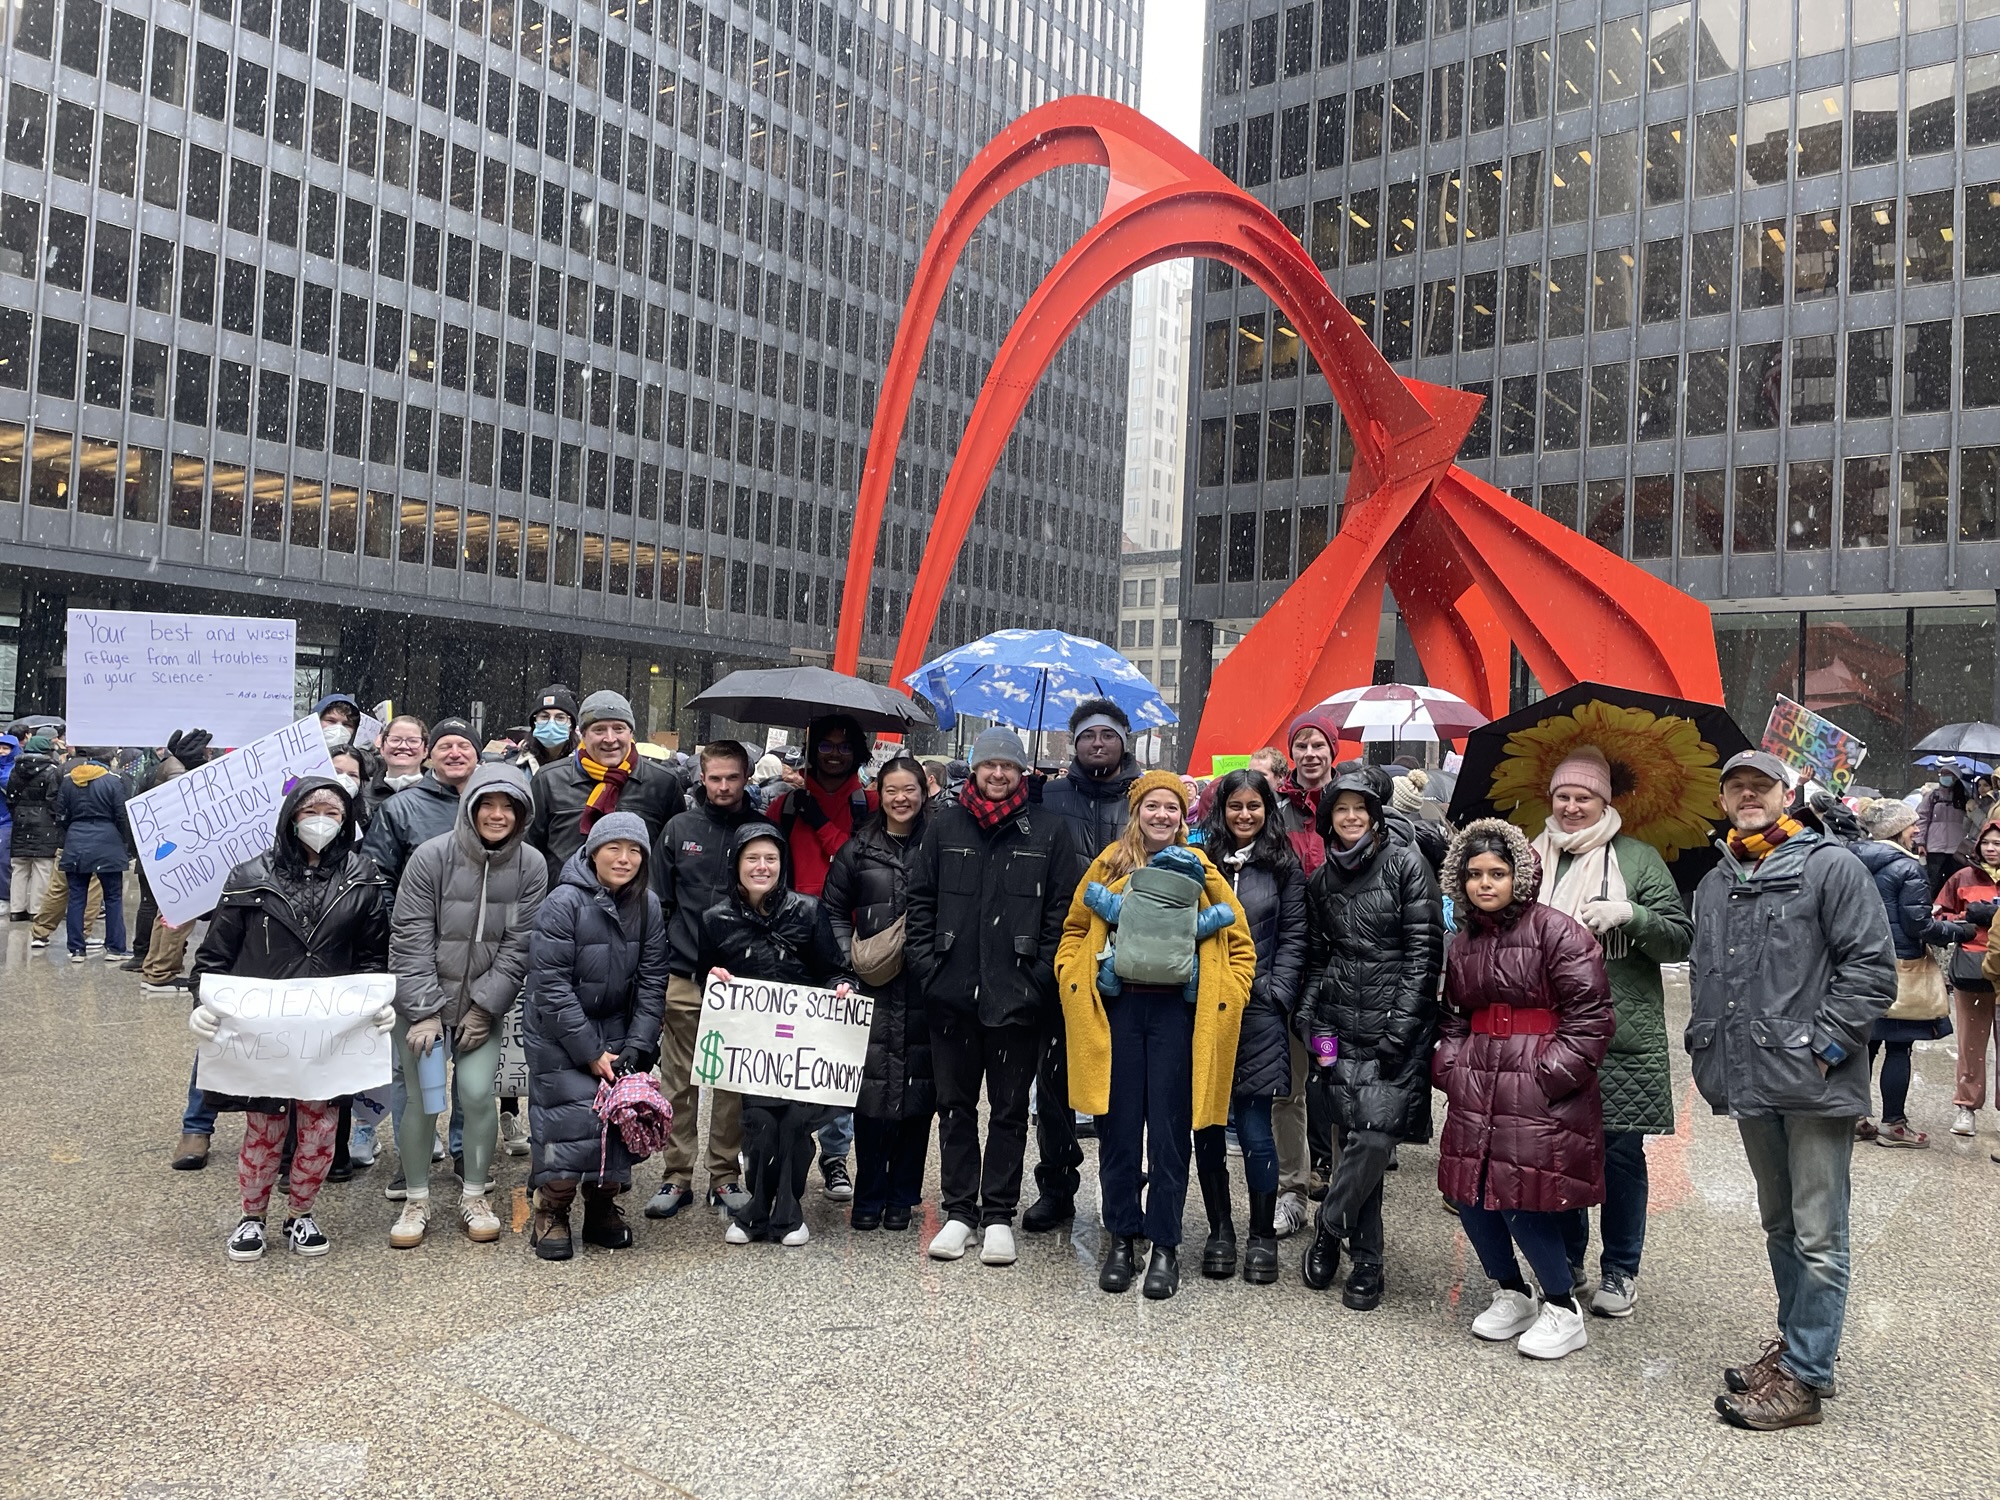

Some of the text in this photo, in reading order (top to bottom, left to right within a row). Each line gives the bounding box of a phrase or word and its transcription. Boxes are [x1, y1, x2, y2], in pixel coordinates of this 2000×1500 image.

[150, 619, 193, 641] best
[206, 627, 236, 641] and
[246, 628, 293, 641] wisest
[84, 647, 288, 670] refuge from all troubles is
[83, 673, 94, 685] in
[104, 672, 137, 691] your
[237, 691, 257, 699] Ada
[129, 718, 318, 843] BE PART OF THE
[180, 781, 271, 849] SOLUTION
[159, 854, 216, 904] STAND
[213, 984, 387, 1020] SCIENCE
[708, 981, 873, 1027] STRONG SCIENCE
[204, 1025, 377, 1060] SAVES LIVES
